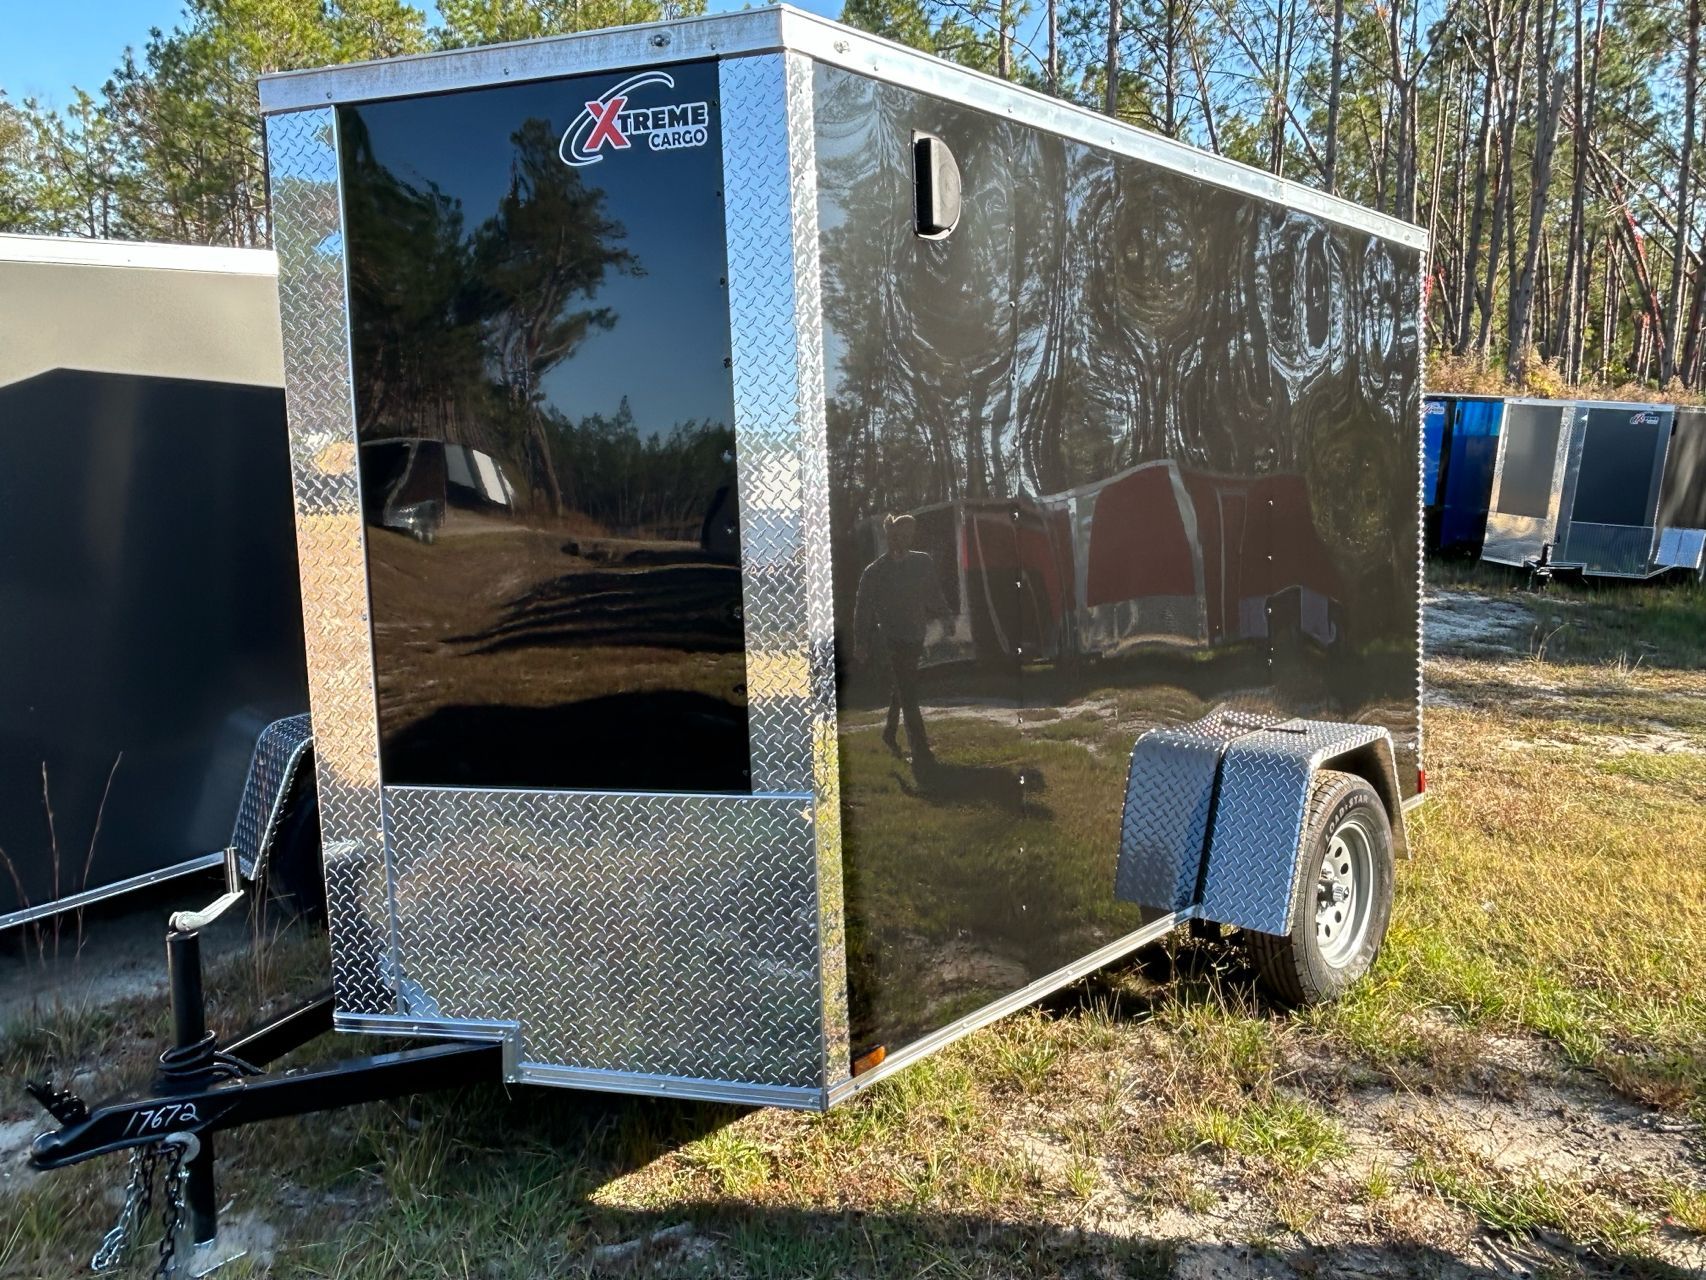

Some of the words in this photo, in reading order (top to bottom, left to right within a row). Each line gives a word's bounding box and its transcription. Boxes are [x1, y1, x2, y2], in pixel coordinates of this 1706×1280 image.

[583, 97, 708, 152] XTREME
[650, 128, 706, 149] CARGO
[122, 1102, 200, 1136] 17672
